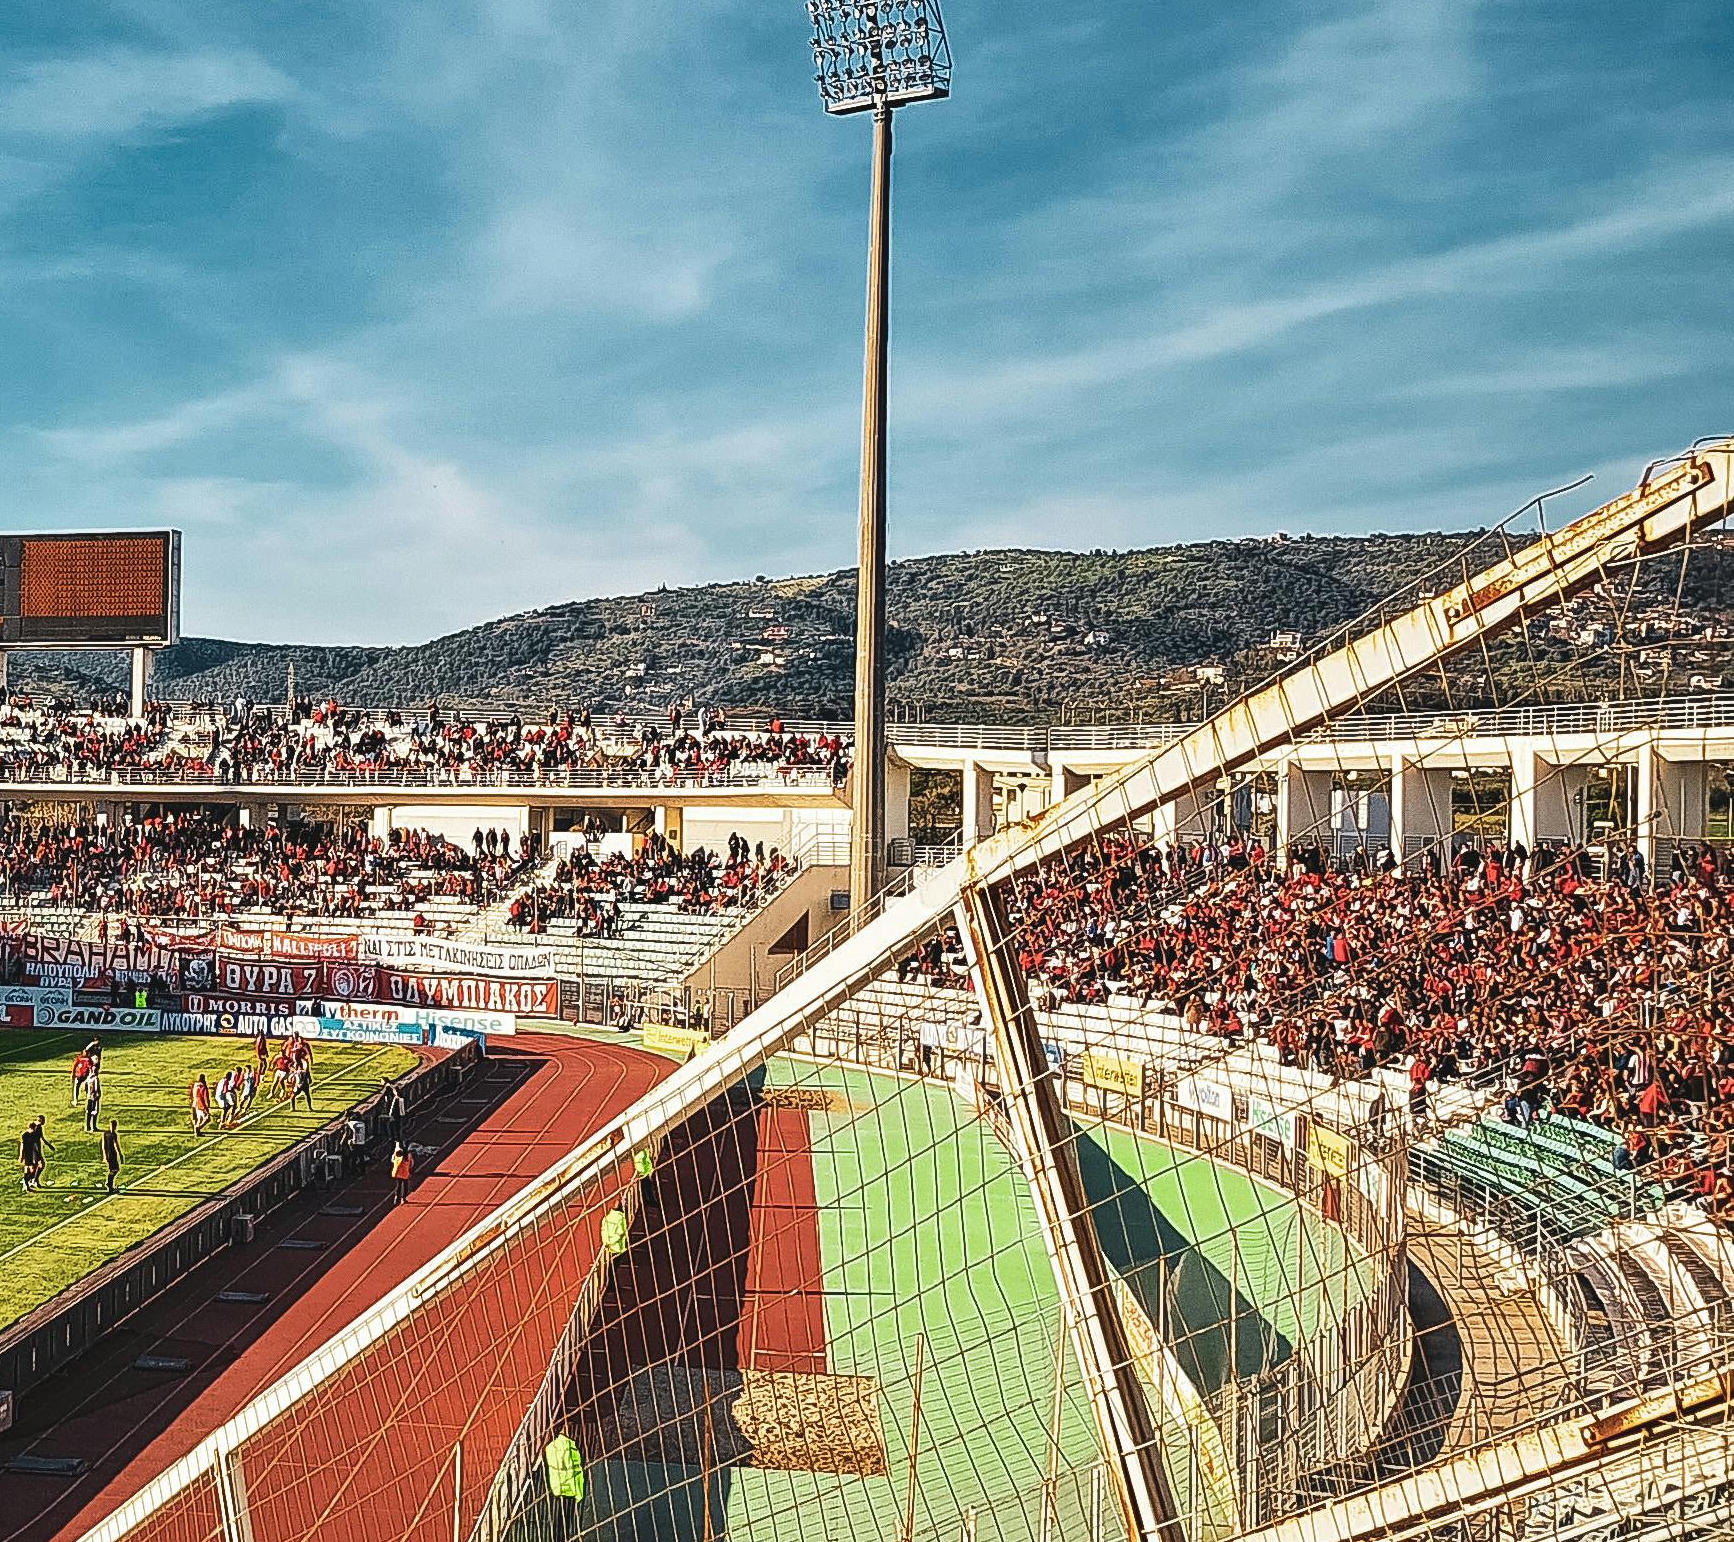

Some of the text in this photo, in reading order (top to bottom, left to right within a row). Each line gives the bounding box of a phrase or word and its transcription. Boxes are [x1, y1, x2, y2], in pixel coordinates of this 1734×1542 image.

[386, 941, 417, 957] ΣΤΙΣ
[226, 964, 295, 993] ΘΥΡΑ
[389, 975, 548, 1012] ΟΛΥΜΠΙΑΚΟΣ
[208, 999, 289, 1015] MORRIS
[237, 1015, 293, 1036] AUTO GAS
[415, 1010, 503, 1031] Hisense
